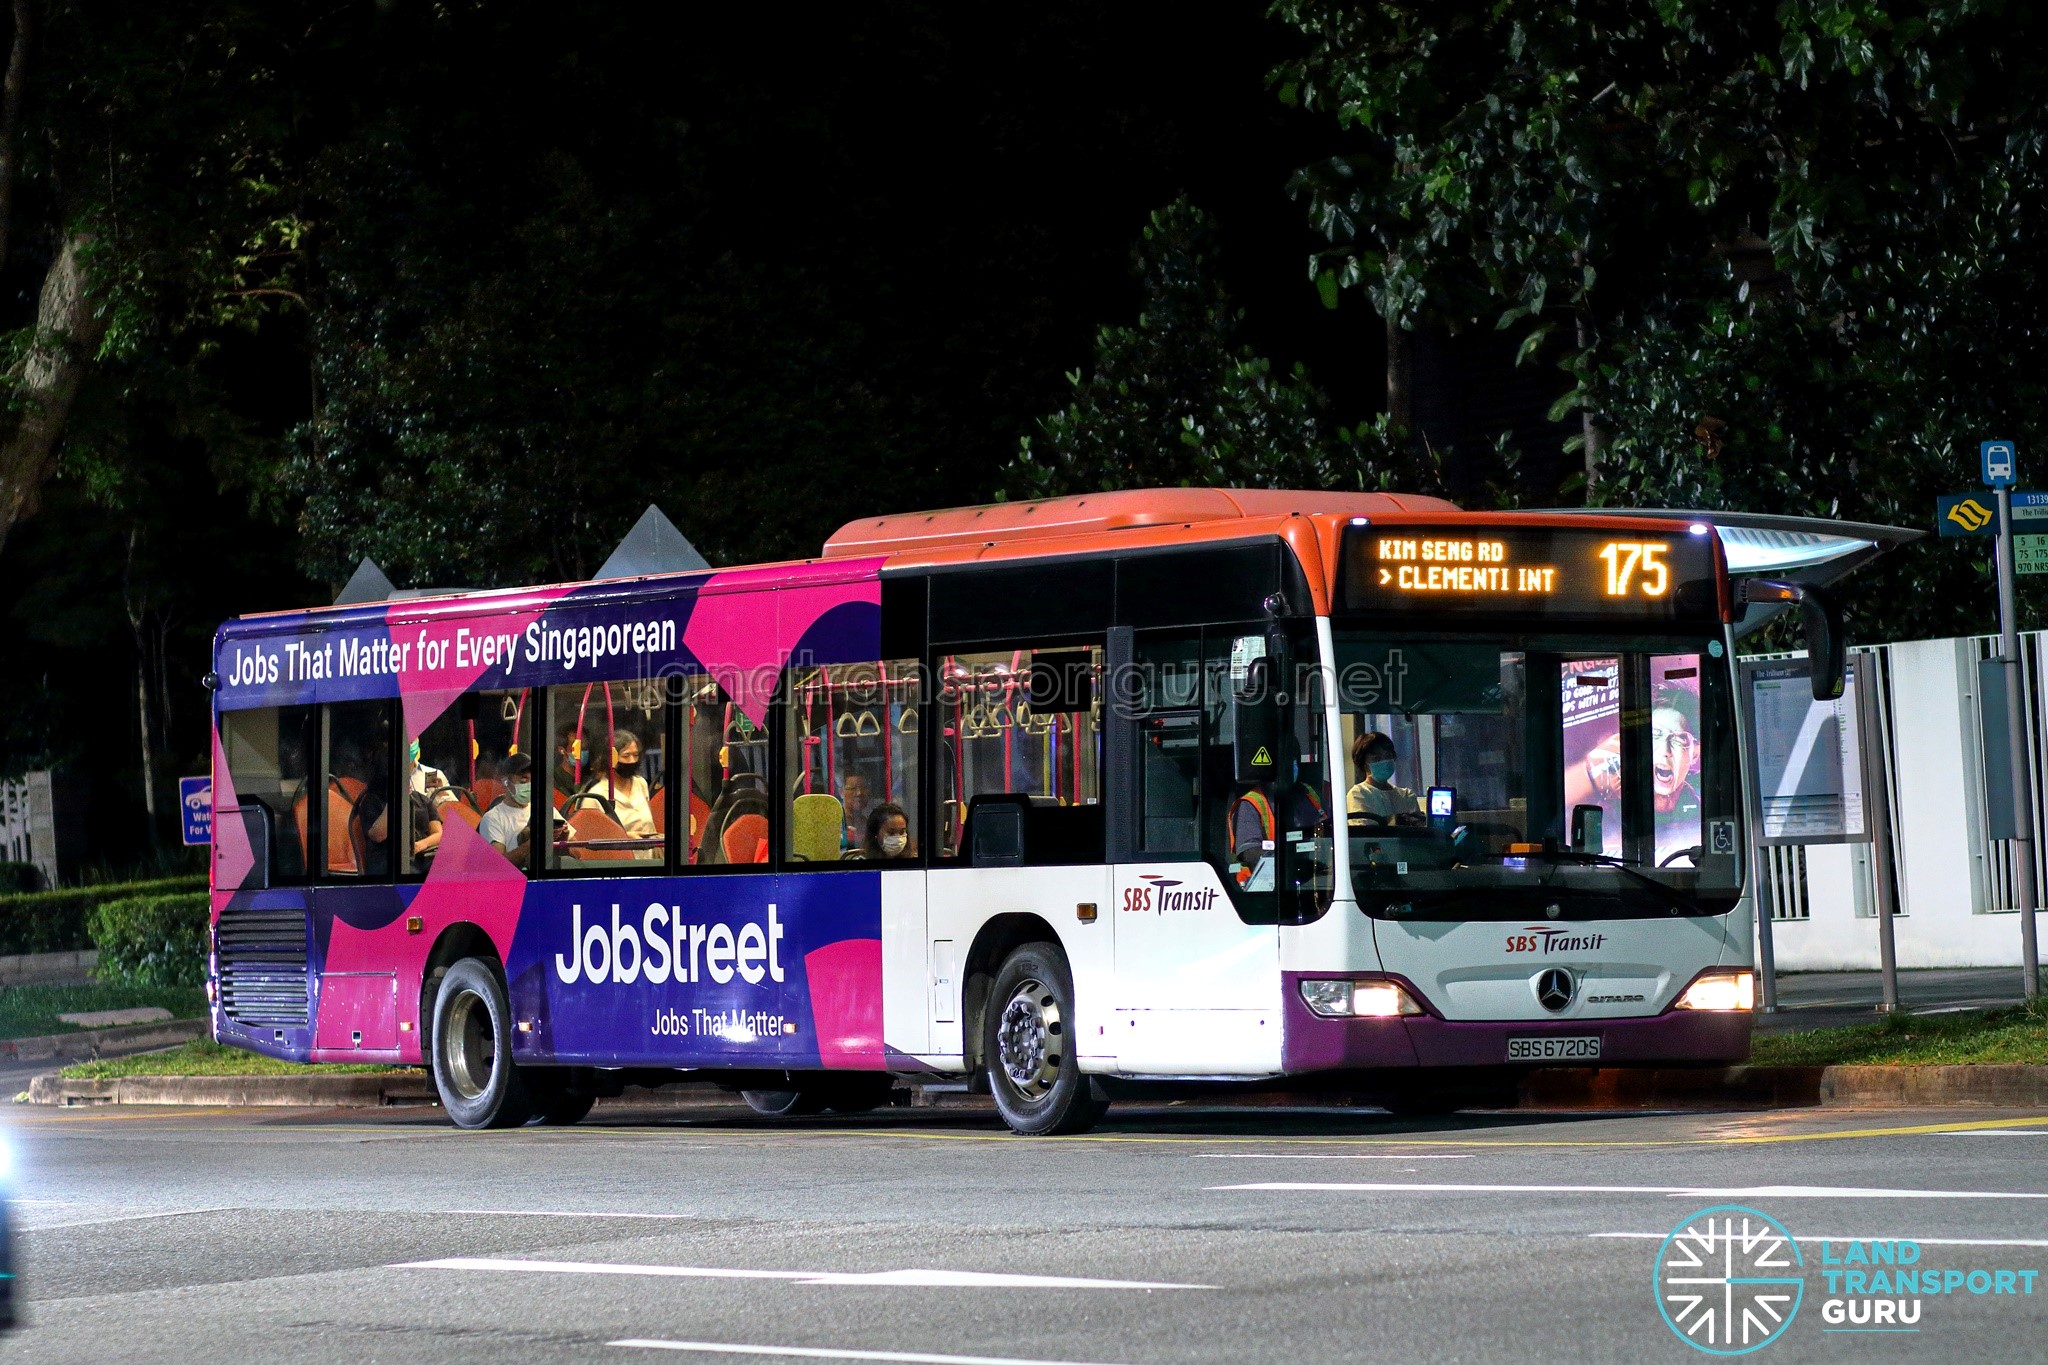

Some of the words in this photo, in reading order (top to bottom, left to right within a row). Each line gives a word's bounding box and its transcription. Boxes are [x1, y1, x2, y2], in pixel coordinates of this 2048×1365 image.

[1379, 540, 1416, 560] KIM
[1421, 541, 1472, 561] SENG
[1477, 542, 1503, 562] RD
[2021, 537, 2026, 546] 5
[2037, 537, 2046, 546] 16
[2019, 550, 2029, 559] 75
[2035, 549, 2048, 559] 175
[1600, 543, 1667, 595] 175
[2018, 563, 2032, 572] 970
[1399, 568, 1509, 590] CLEMENTI
[1518, 568, 1554, 592] INT
[229, 644, 279, 687] Jobs
[285, 641, 332, 681] That
[339, 637, 410, 677] Matter
[417, 629, 449, 671] for
[456, 628, 518, 675] Every
[525, 619, 676, 670] Singaporean
[190, 825, 203, 835] For
[1123, 887, 1151, 911] SBS
[1149, 880, 1219, 916] Transit
[555, 902, 785, 984] JobStreet
[1505, 936, 1537, 952] SBS
[1536, 930, 1608, 955] Transit
[651, 1008, 688, 1035] Jobs
[692, 1008, 727, 1036] That
[732, 1009, 783, 1036] Matter
